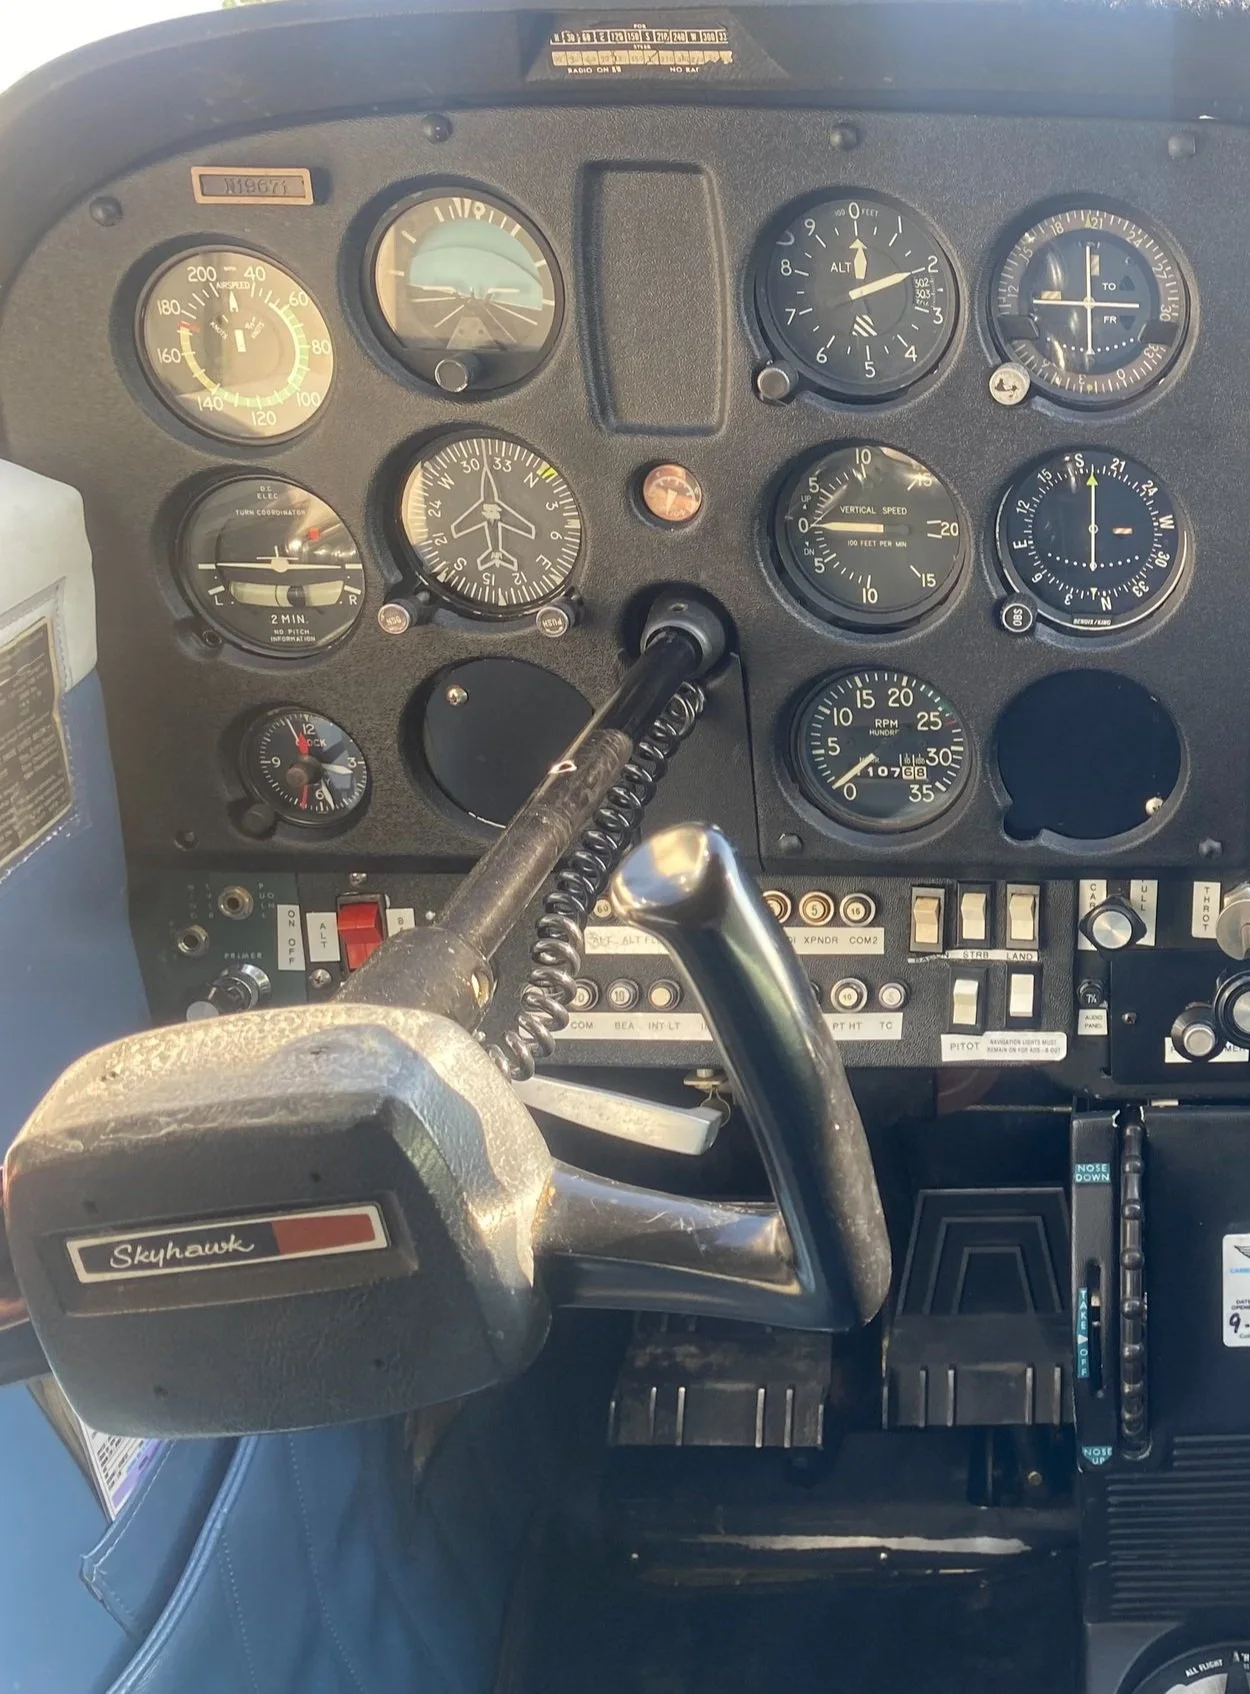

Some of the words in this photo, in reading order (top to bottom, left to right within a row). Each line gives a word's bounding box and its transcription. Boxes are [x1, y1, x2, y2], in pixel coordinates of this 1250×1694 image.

[849, 202, 860, 219] 0
[862, 209, 878, 217] FEET
[804, 218, 816, 236] 9
[1051, 222, 1064, 236] 18
[1091, 217, 1103, 228] 21
[780, 259, 792, 276] 8
[831, 263, 851, 273] ALT
[928, 256, 938, 273] 2
[187, 267, 216, 282] 200
[244, 266, 266, 281] 40
[1102, 283, 1116, 291] TO
[289, 291, 308, 306] 60
[158, 300, 181, 315] 180
[785, 308, 796, 325] 7
[933, 307, 944, 324] 3
[1104, 316, 1117, 324] FR
[312, 340, 331, 355] 80
[905, 345, 917, 362] 4
[157, 348, 181, 363] 160
[817, 347, 827, 364] 6
[865, 362, 876, 378] 5
[198, 396, 224, 411] 140
[297, 392, 321, 407] 100
[252, 411, 276, 426] 120
[855, 448, 872, 465] 10
[1074, 453, 1085, 468] S
[460, 458, 480, 474] 30
[493, 458, 512, 473] 33
[1111, 457, 1126, 473] 21
[437, 473, 455, 490] W
[523, 473, 540, 489] N
[809, 477, 819, 494] 5
[1141, 480, 1158, 497] 24
[428, 500, 443, 518] 24
[546, 502, 558, 511] 3
[840, 506, 876, 515] VERTICAL
[882, 507, 907, 515] SPEED
[941, 522, 959, 536] 20
[1159, 514, 1175, 530] W
[434, 532, 448, 546] 21
[1013, 539, 1028, 550] E
[454, 557, 467, 571] S
[814, 558, 825, 574] 5
[1155, 551, 1170, 569] 30
[922, 573, 937, 588] 15
[215, 595, 224, 606] L
[863, 587, 878, 604] 10
[1013, 608, 1023, 627] OBS
[856, 690, 875, 709] 15
[888, 687, 914, 708] 20
[833, 707, 853, 726] 10
[875, 720, 898, 728] RPM
[917, 711, 942, 731] 25
[303, 723, 315, 735] 12
[828, 737, 840, 755] 5
[271, 757, 281, 768] 9
[347, 757, 356, 768] 3
[926, 748, 952, 766] 30
[315, 788, 324, 800] 6
[844, 783, 857, 800] 0
[909, 785, 934, 802] 35
[1202, 887, 1210, 932] THROT
[287, 910, 295, 928] ON
[319, 923, 327, 949] ALT
[850, 936, 878, 944] COM2
[288, 938, 296, 965] OFF
[833, 1022, 844, 1030] PT
[849, 1022, 862, 1030] HT
[880, 1022, 893, 1030] TC
[950, 1042, 980, 1050] PITOT
[1078, 1164, 1107, 1172] NOSE
[1076, 1174, 1110, 1182] DOWN
[110, 1234, 254, 1269] Skyhawk
[1080, 1349, 1088, 1376] OFF
[1084, 1447, 1112, 1456] NOSE
[1092, 1456, 1105, 1465] UP
[1185, 1666, 1198, 1678] ALL
[1200, 1659, 1224, 1672] FLIGHT
